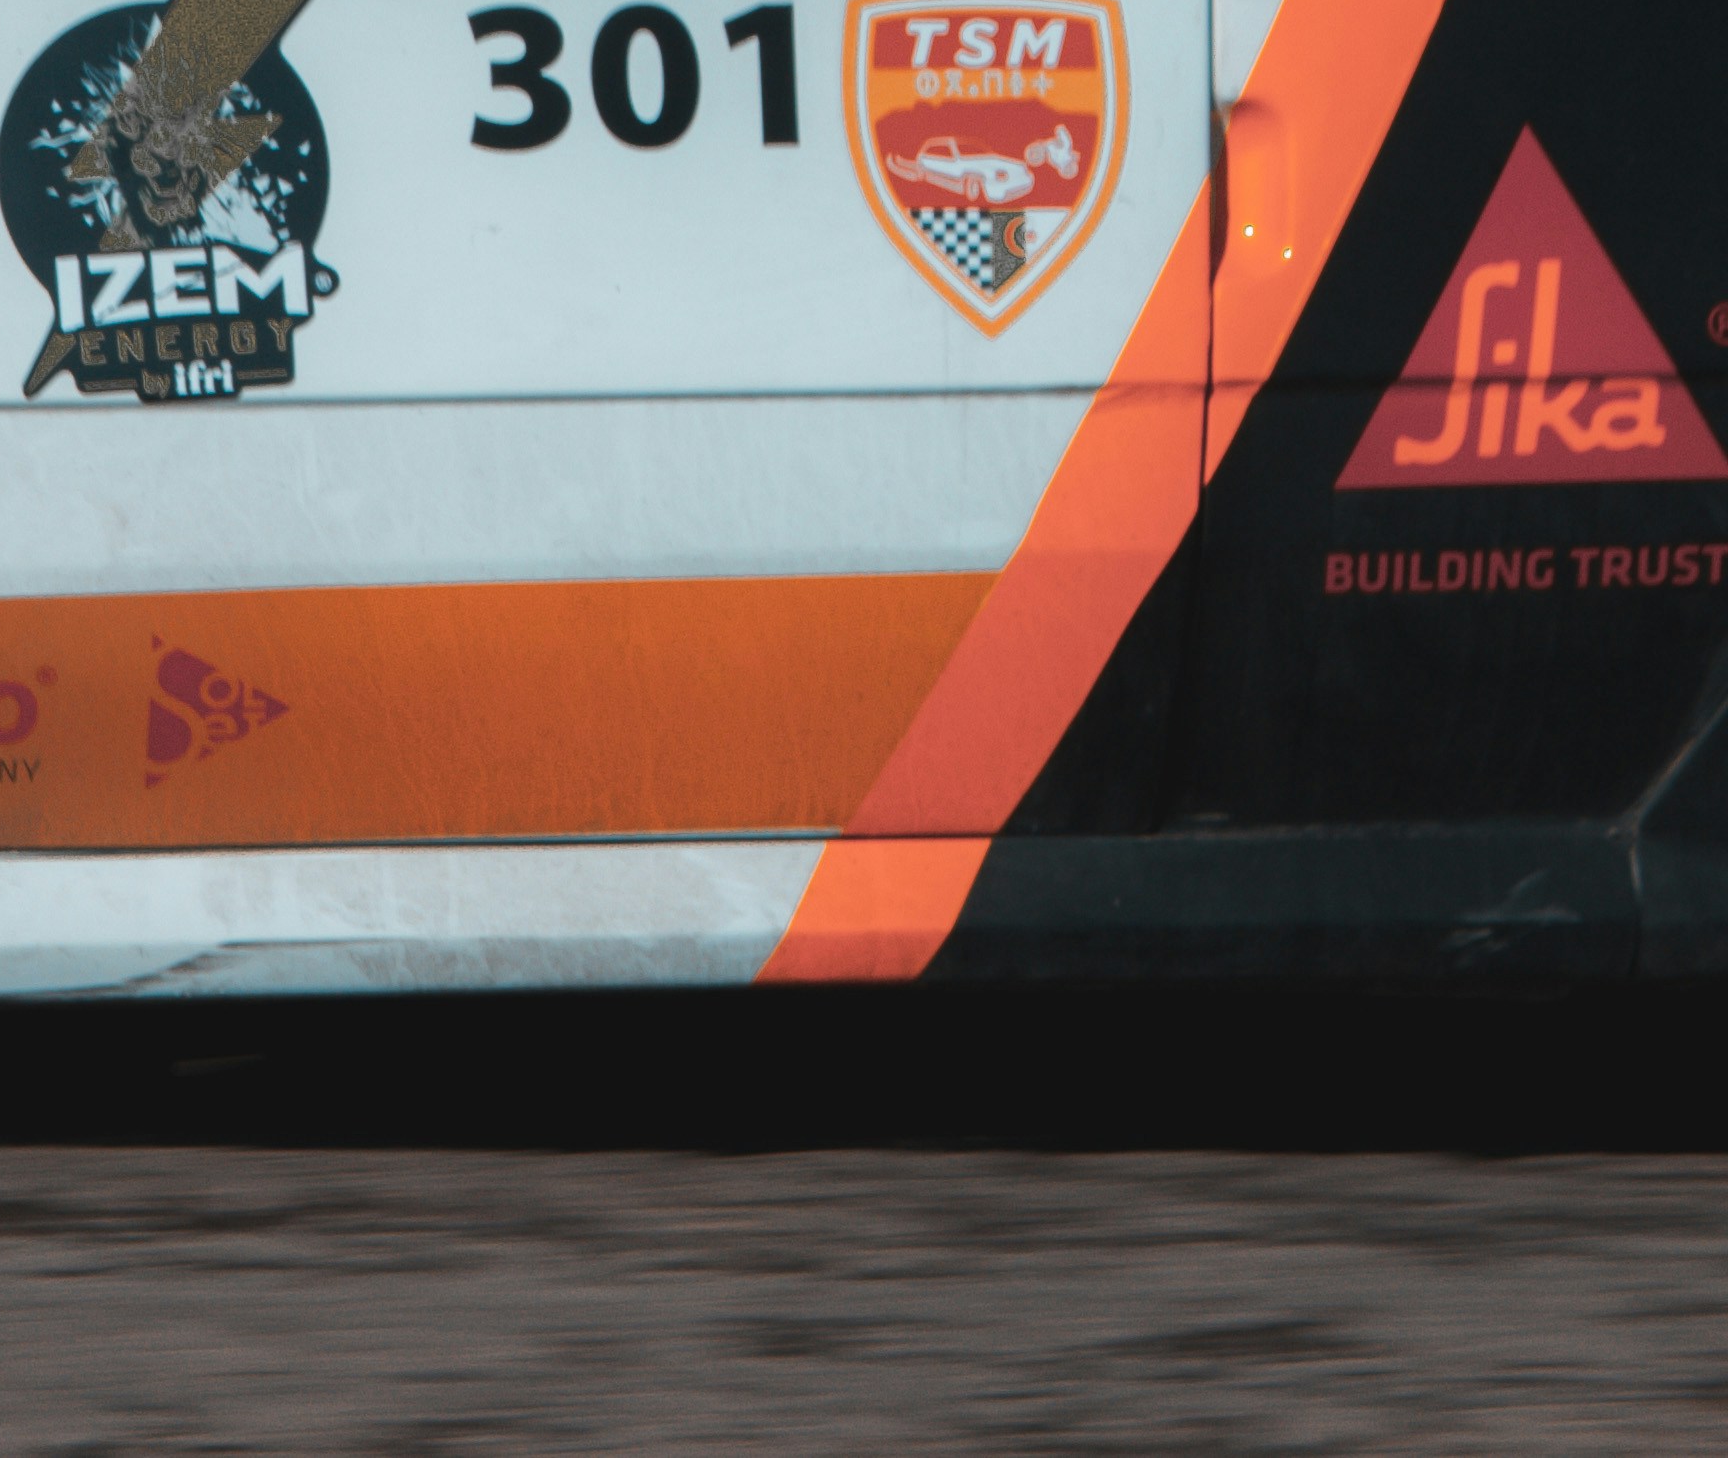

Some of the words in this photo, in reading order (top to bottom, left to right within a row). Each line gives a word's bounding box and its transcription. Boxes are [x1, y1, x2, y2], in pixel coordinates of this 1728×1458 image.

[466, 1, 801, 151] 301
[907, 17, 1067, 69] TSM
[54, 240, 311, 333] IZEM
[78, 317, 295, 366] ENERGY
[1393, 258, 1668, 466] Sika
[1324, 550, 1555, 595] BUILDING
[1571, 543, 1728, 590] TRUST
